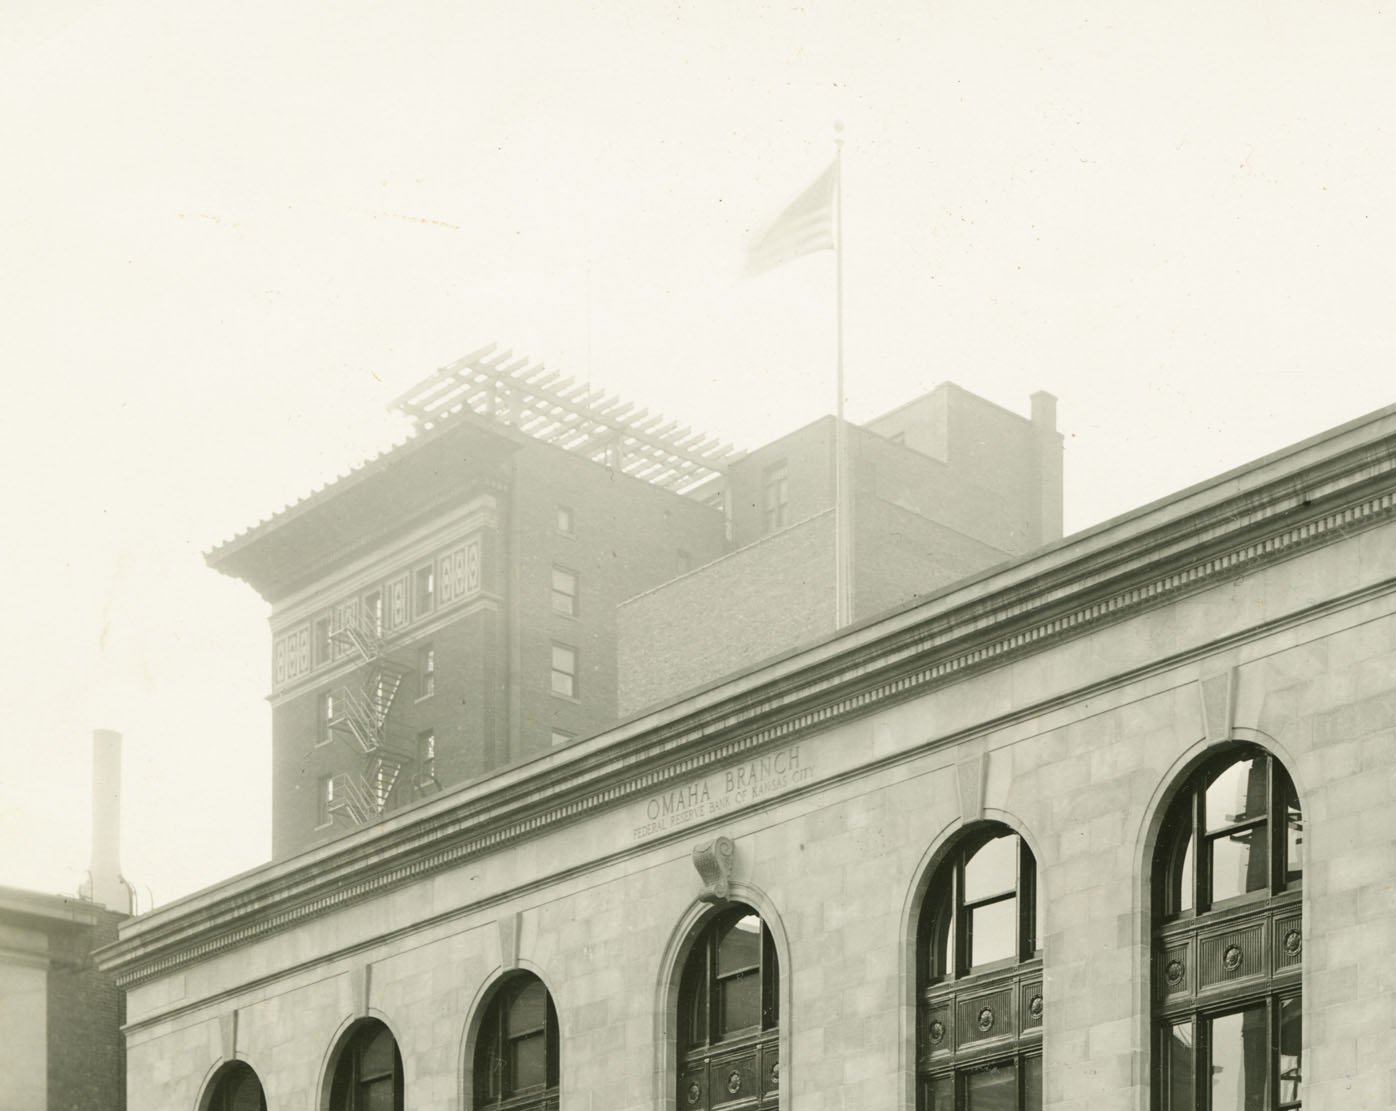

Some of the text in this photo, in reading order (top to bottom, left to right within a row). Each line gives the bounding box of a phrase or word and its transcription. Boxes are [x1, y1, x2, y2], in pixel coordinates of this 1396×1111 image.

[633, 765, 815, 840] FEDERAL RESERVE BANK OF KANSAS CITY
[647, 746, 801, 820] OMAHA BRANCH
